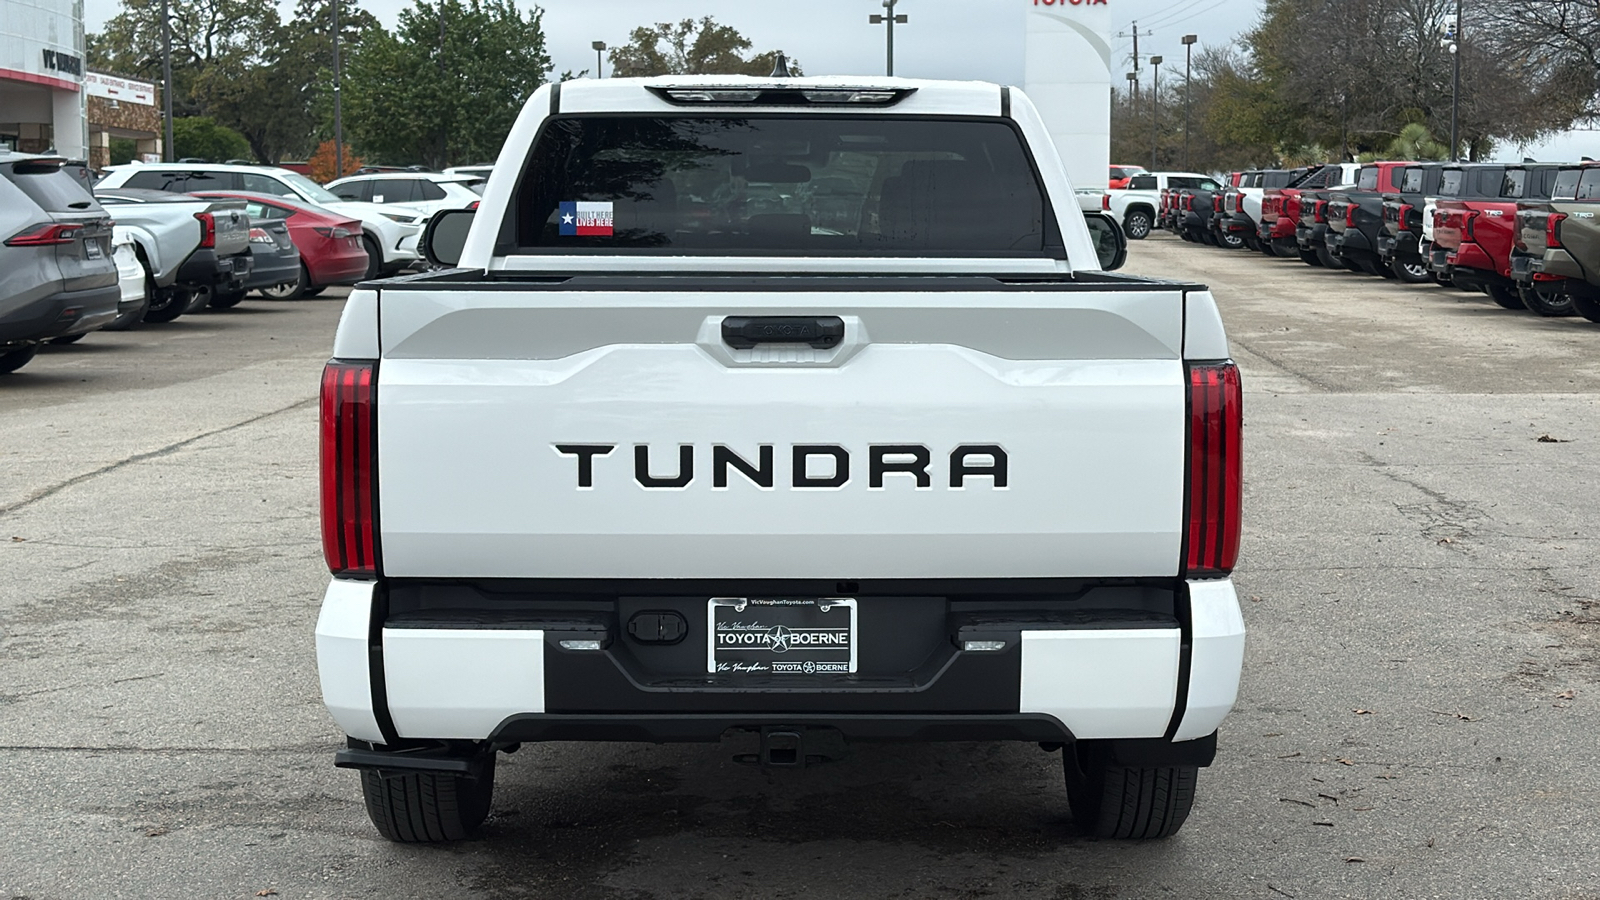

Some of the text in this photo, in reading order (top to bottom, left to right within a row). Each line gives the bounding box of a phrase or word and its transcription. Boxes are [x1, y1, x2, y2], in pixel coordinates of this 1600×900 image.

[576, 211, 613, 219] BUILT HERE
[1573, 211, 1594, 219] TRD
[576, 218, 613, 226] LIVES HERE
[756, 324, 810, 335] TOYOTA
[553, 443, 1010, 489] TUNDRA
[717, 633, 771, 644] TOYOTA
[790, 633, 848, 644] BOERNE
